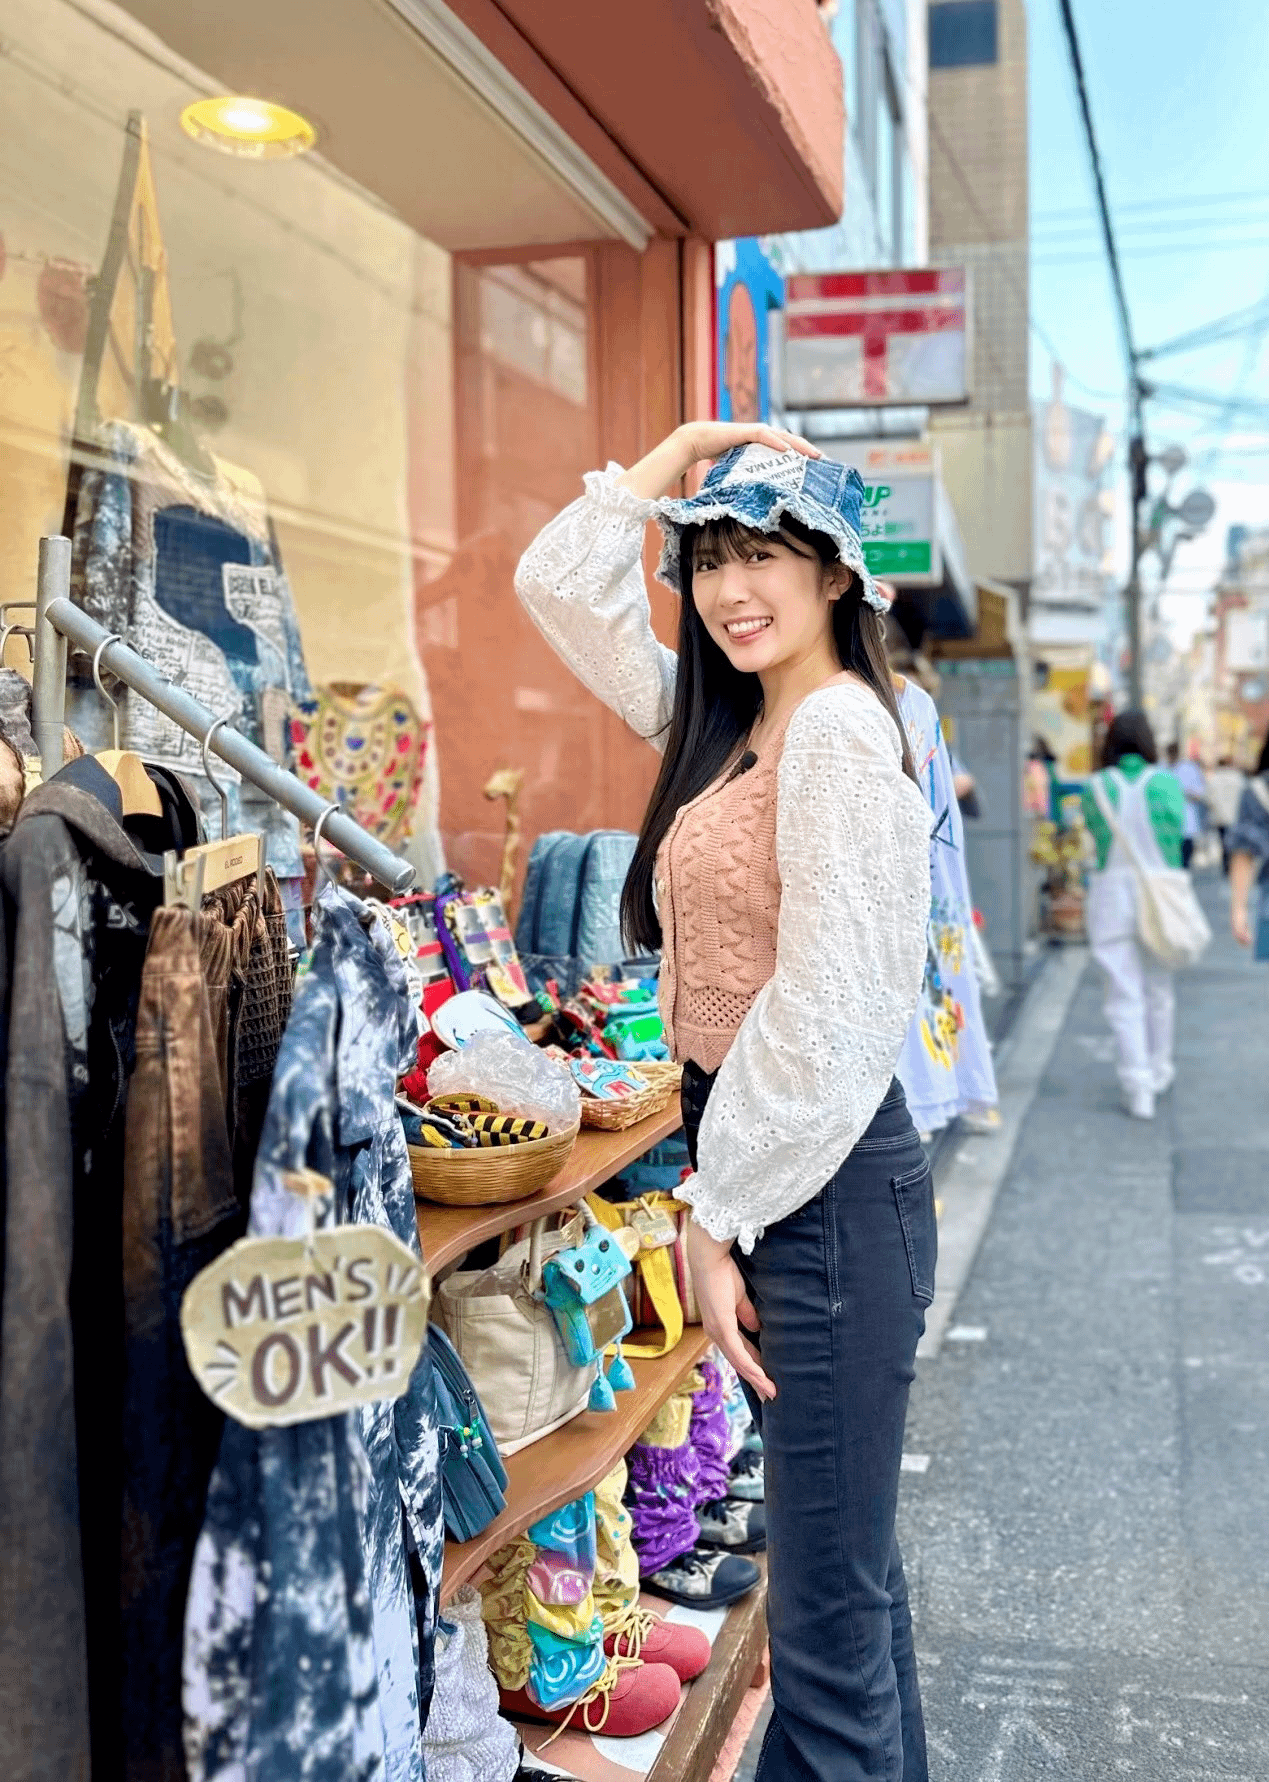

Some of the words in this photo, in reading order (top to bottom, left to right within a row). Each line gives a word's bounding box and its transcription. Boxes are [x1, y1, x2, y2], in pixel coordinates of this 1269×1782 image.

[745, 454, 793, 474] UTAMA
[220, 1255, 374, 1329] MEN'S
[251, 1303, 402, 1408] OK!!
